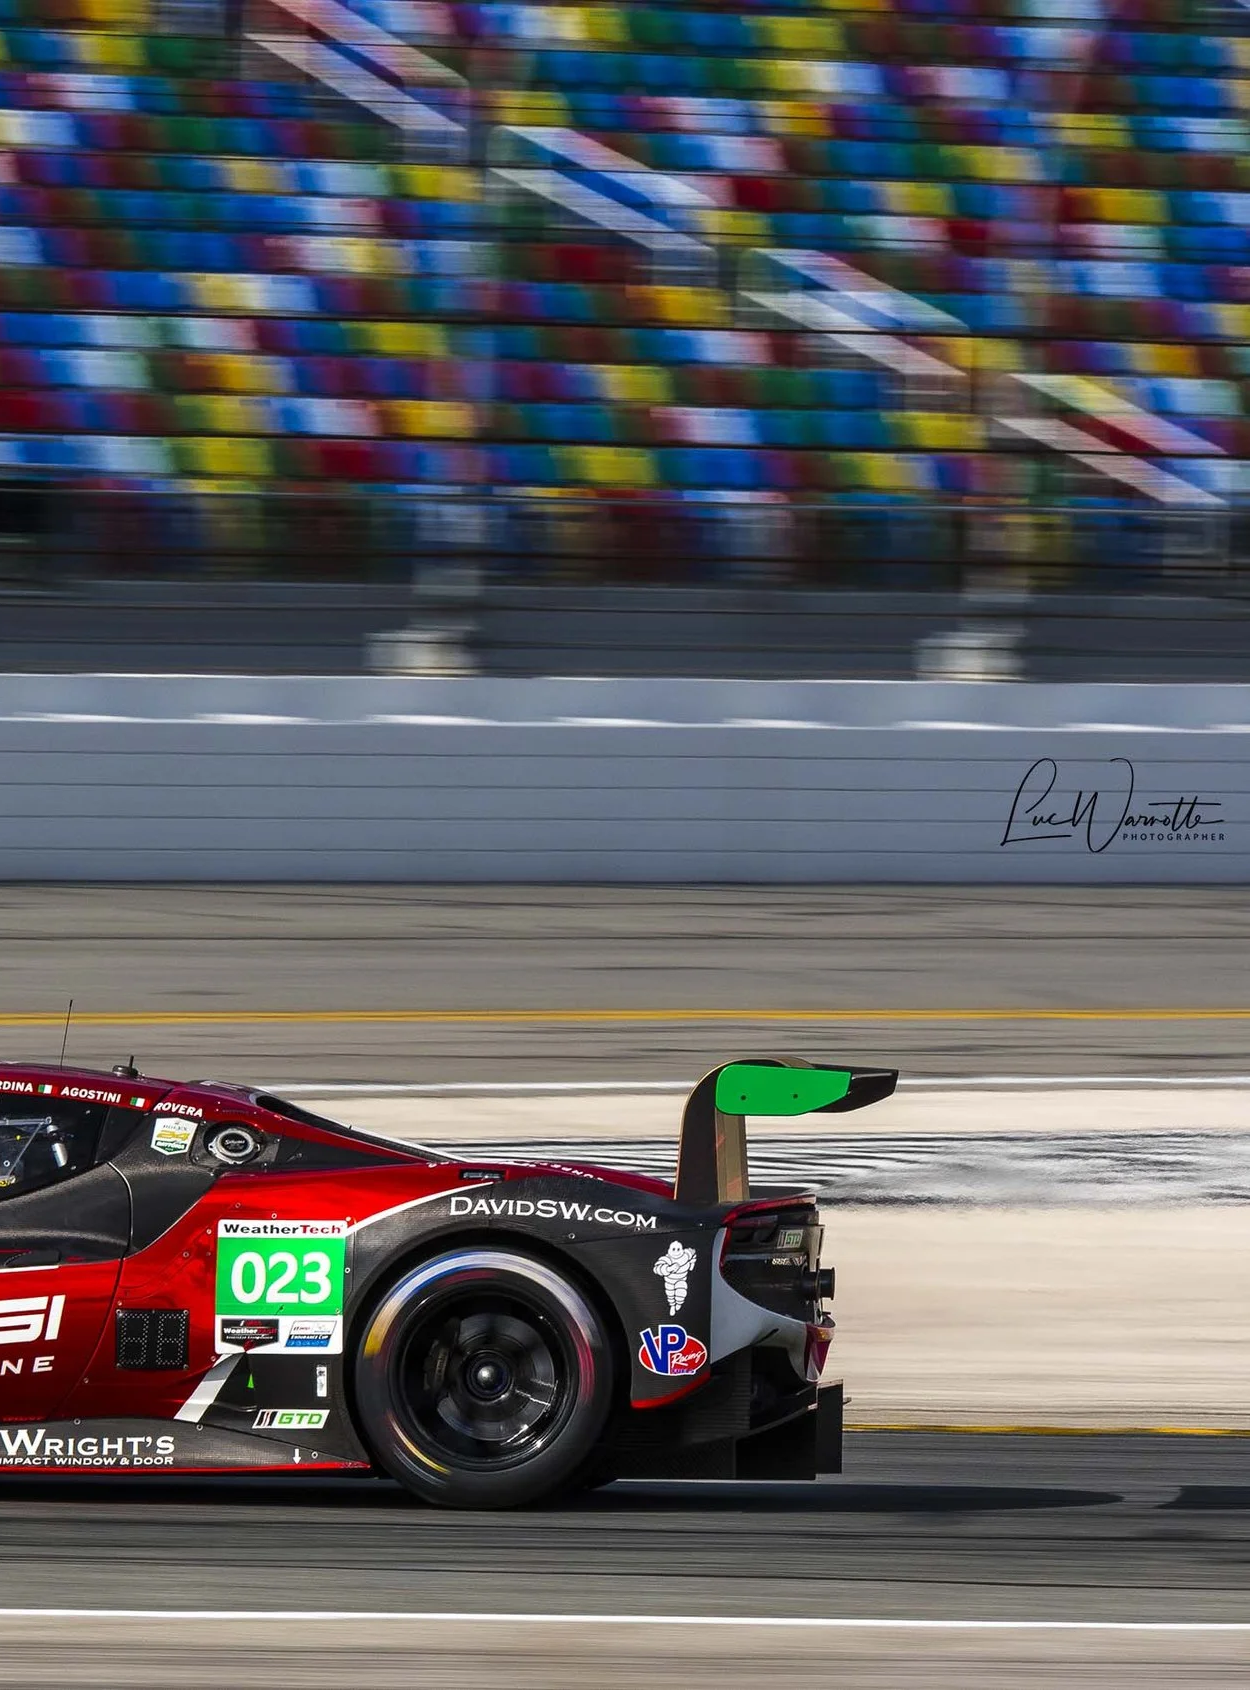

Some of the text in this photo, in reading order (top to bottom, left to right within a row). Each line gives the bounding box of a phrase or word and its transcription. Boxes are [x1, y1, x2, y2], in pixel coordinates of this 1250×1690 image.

[60, 1086, 122, 1104] AGOSTINI
[153, 1101, 204, 1118] ROVERA
[223, 1223, 341, 1235] WeatherTech
[230, 1250, 333, 1305] 023
[640, 1325, 688, 1375] VP
[277, 1412, 323, 1425] GTD
[55, 1456, 118, 1466] WINDOW
[120, 1456, 130, 1466] &
[133, 1456, 174, 1465] DOOR
